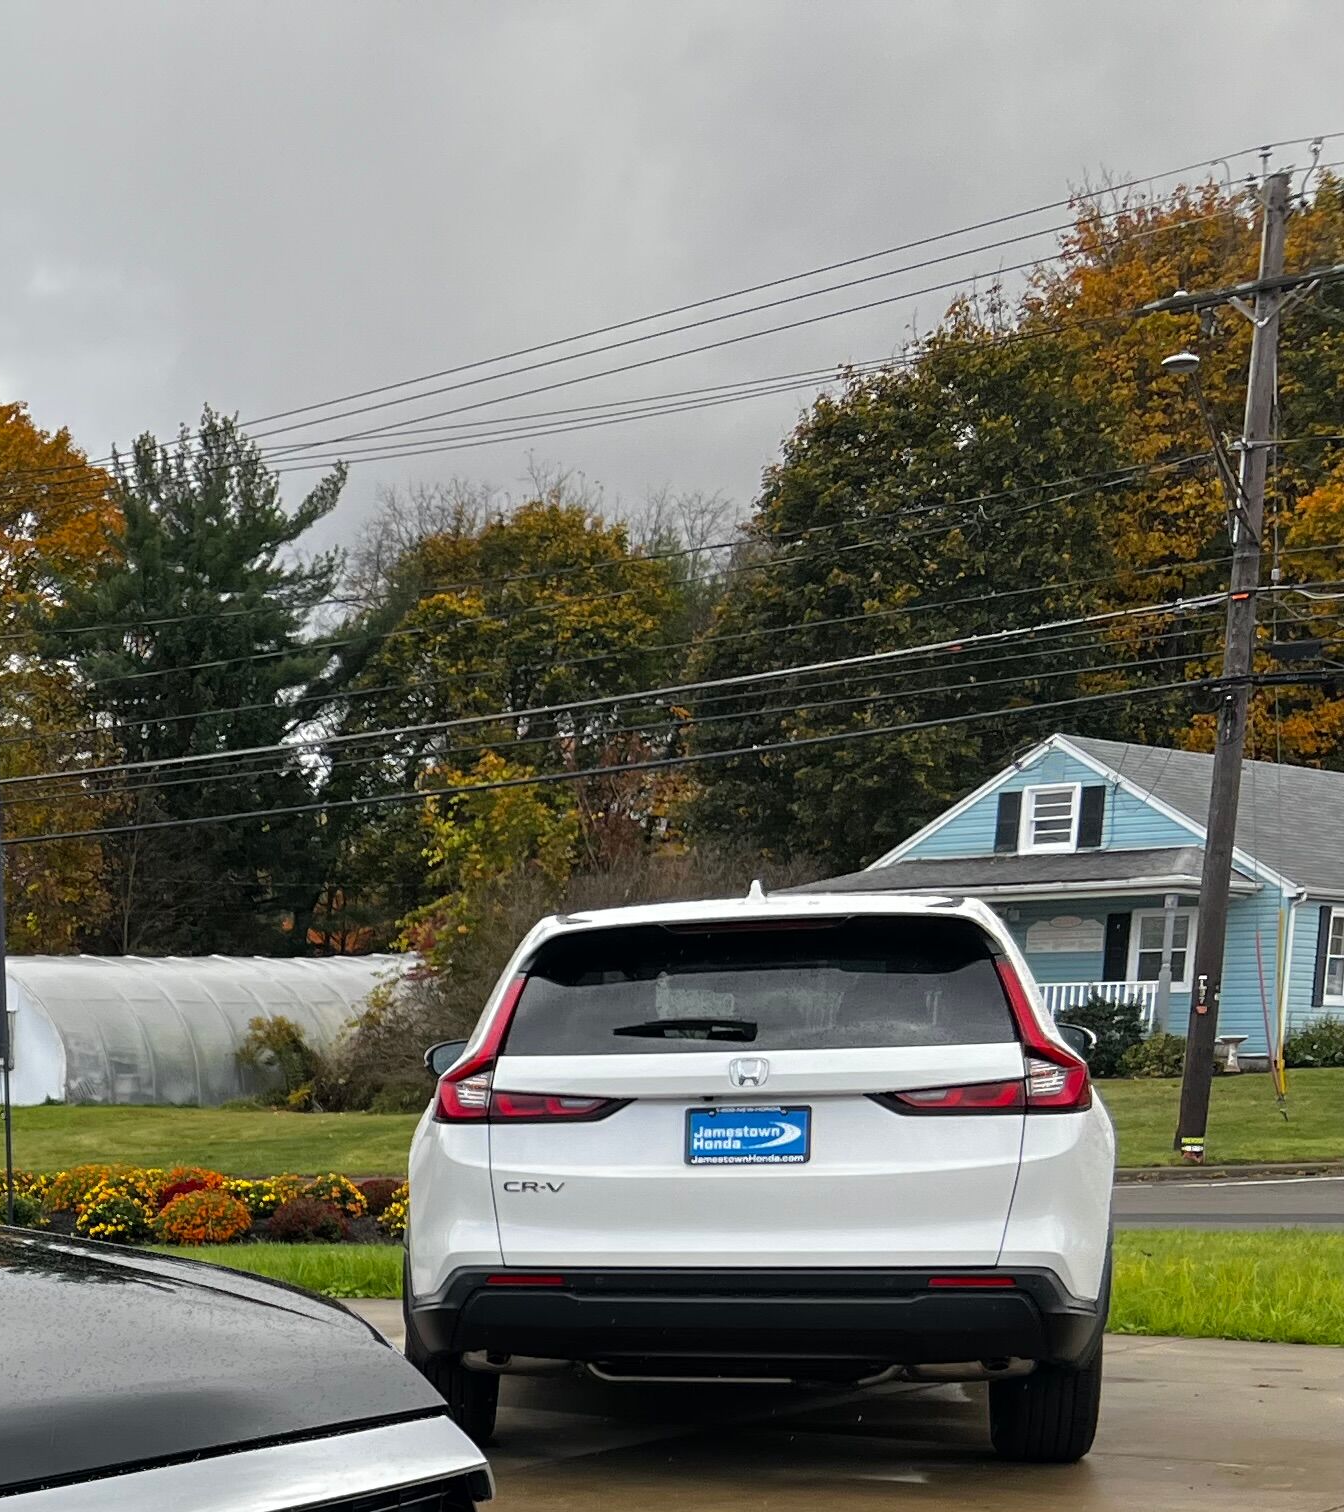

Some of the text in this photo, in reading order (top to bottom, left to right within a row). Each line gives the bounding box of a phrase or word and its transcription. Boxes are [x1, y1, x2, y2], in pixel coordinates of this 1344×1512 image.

[694, 1126, 780, 1138] Jamestown
[693, 1138, 742, 1150] Honda
[691, 1154, 804, 1164] JamestownHonda.com
[503, 1181, 565, 1193] CR-V
